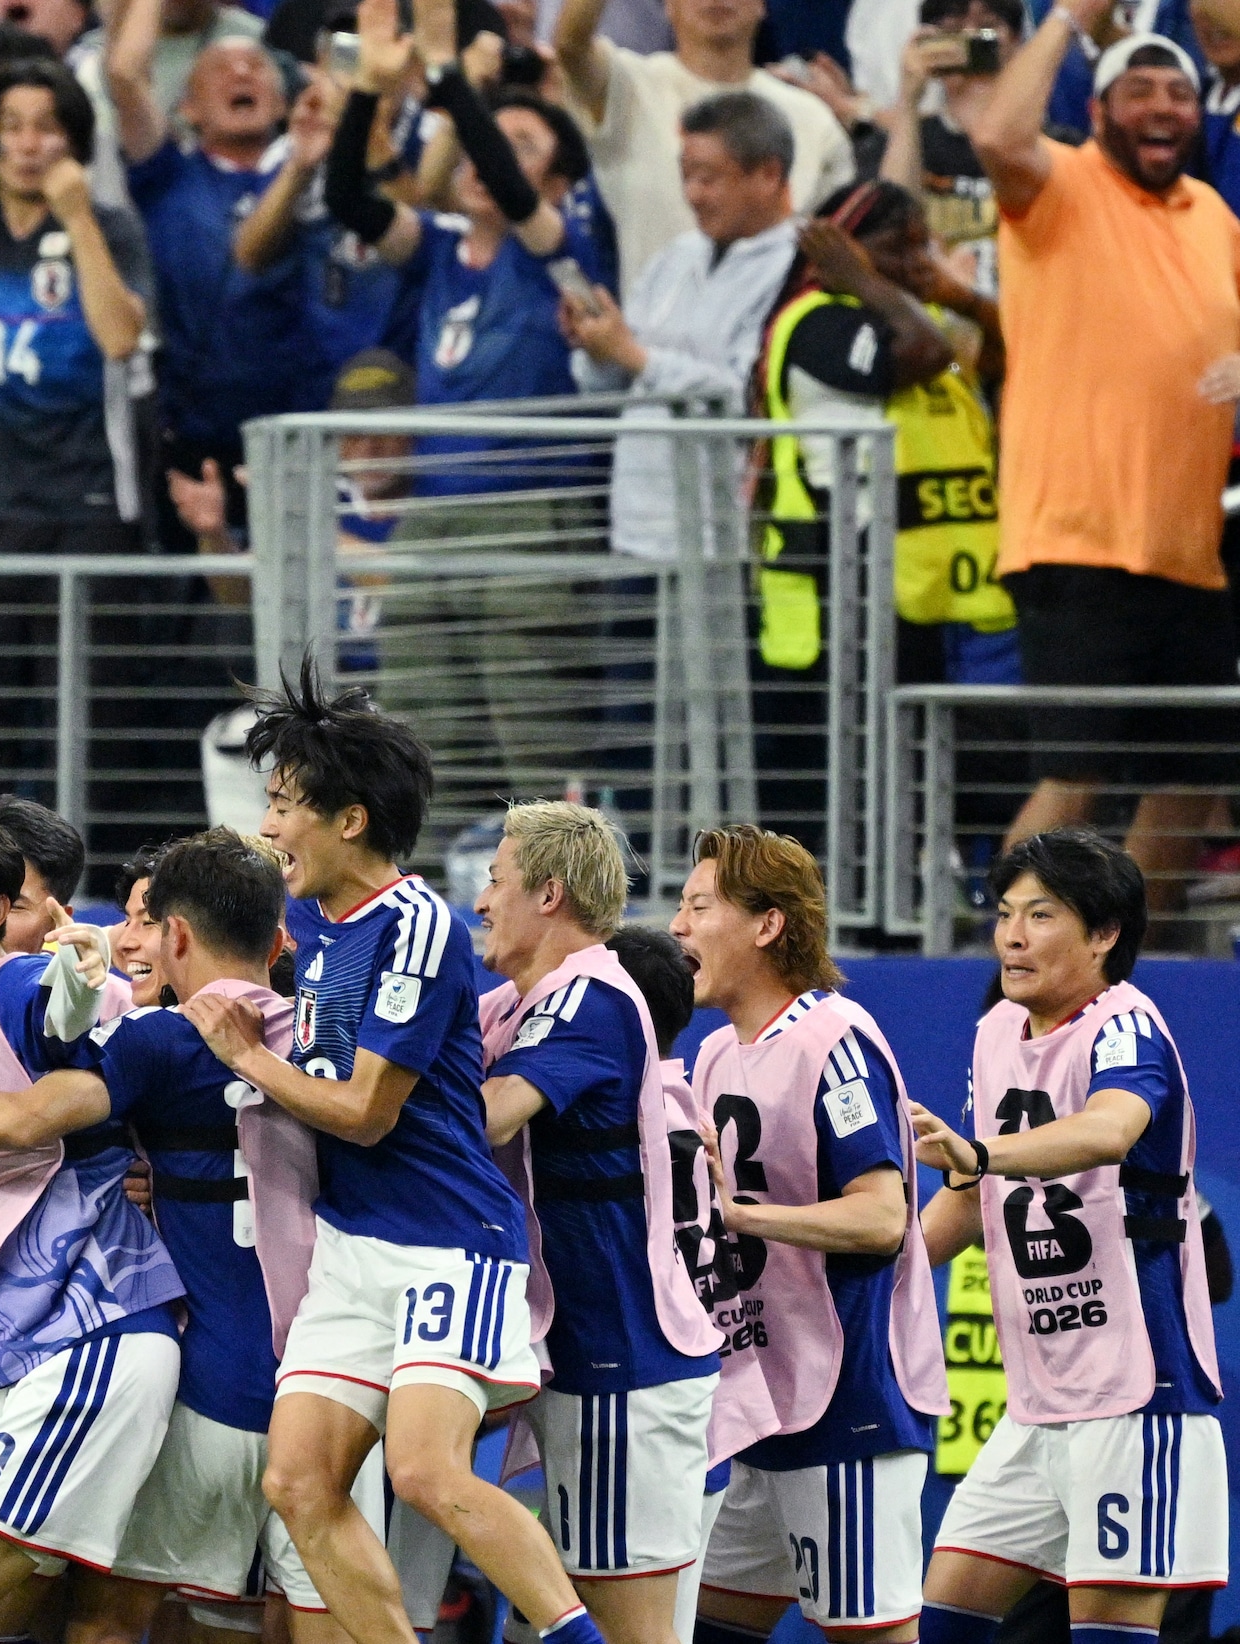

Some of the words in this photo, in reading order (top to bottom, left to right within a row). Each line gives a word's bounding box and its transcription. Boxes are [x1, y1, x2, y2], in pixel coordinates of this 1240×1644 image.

[843, 1110, 864, 1124] PEACE
[1026, 1238, 1066, 1261] FIFA
[1022, 1286, 1064, 1305] ORLD
[1066, 1279, 1103, 1299] CUP
[403, 1282, 456, 1346] 13
[717, 1308, 746, 1328] CU
[942, 1400, 1007, 1443] 36
[1098, 1493, 1130, 1560] 6
